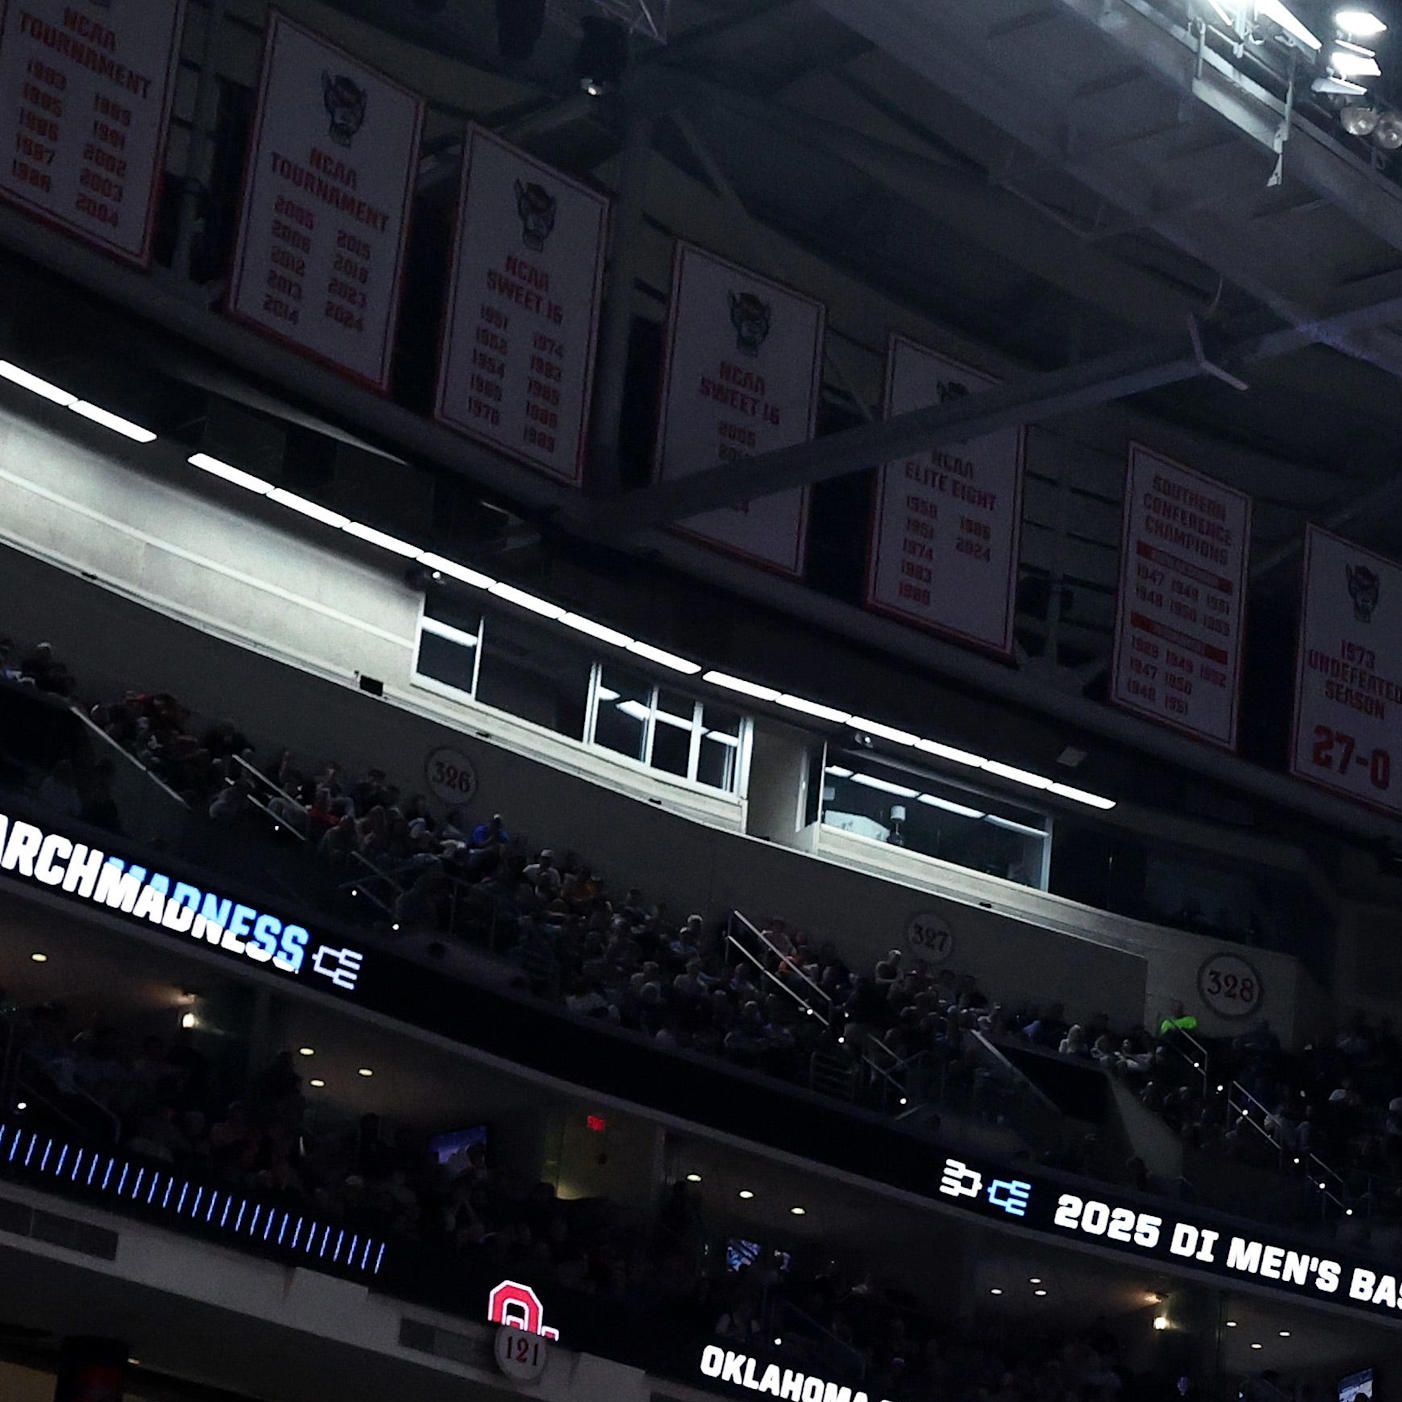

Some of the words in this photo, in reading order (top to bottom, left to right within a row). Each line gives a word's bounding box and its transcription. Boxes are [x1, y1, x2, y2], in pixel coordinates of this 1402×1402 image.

[20, 10, 151, 99] TOURNAMENT
[271, 151, 389, 234] TOURNAMENT
[487, 269, 543, 314] SWEET
[505, 255, 549, 292] NCAA
[699, 376, 760, 416] SWEET
[905, 462, 948, 491] ELITE
[952, 480, 996, 511] EIGHT
[1152, 474, 1226, 522] SOUTHERN
[1143, 492, 1233, 547] CONFERENCE
[1145, 515, 1230, 566] CHAMPIONS
[1340, 638, 1377, 669] 1973
[1324, 679, 1386, 720] SEASON
[432, 760, 472, 794] 326
[1312, 724, 1392, 791] 27-0
[0, 813, 310, 975] RCHMADNESS
[911, 922, 950, 953] 327
[1206, 967, 1256, 1004] 328
[1053, 1194, 1163, 1249] 2025
[1170, 1221, 1218, 1263] DI
[1226, 1236, 1342, 1295] MEN'S
[505, 1335, 540, 1367] 121
